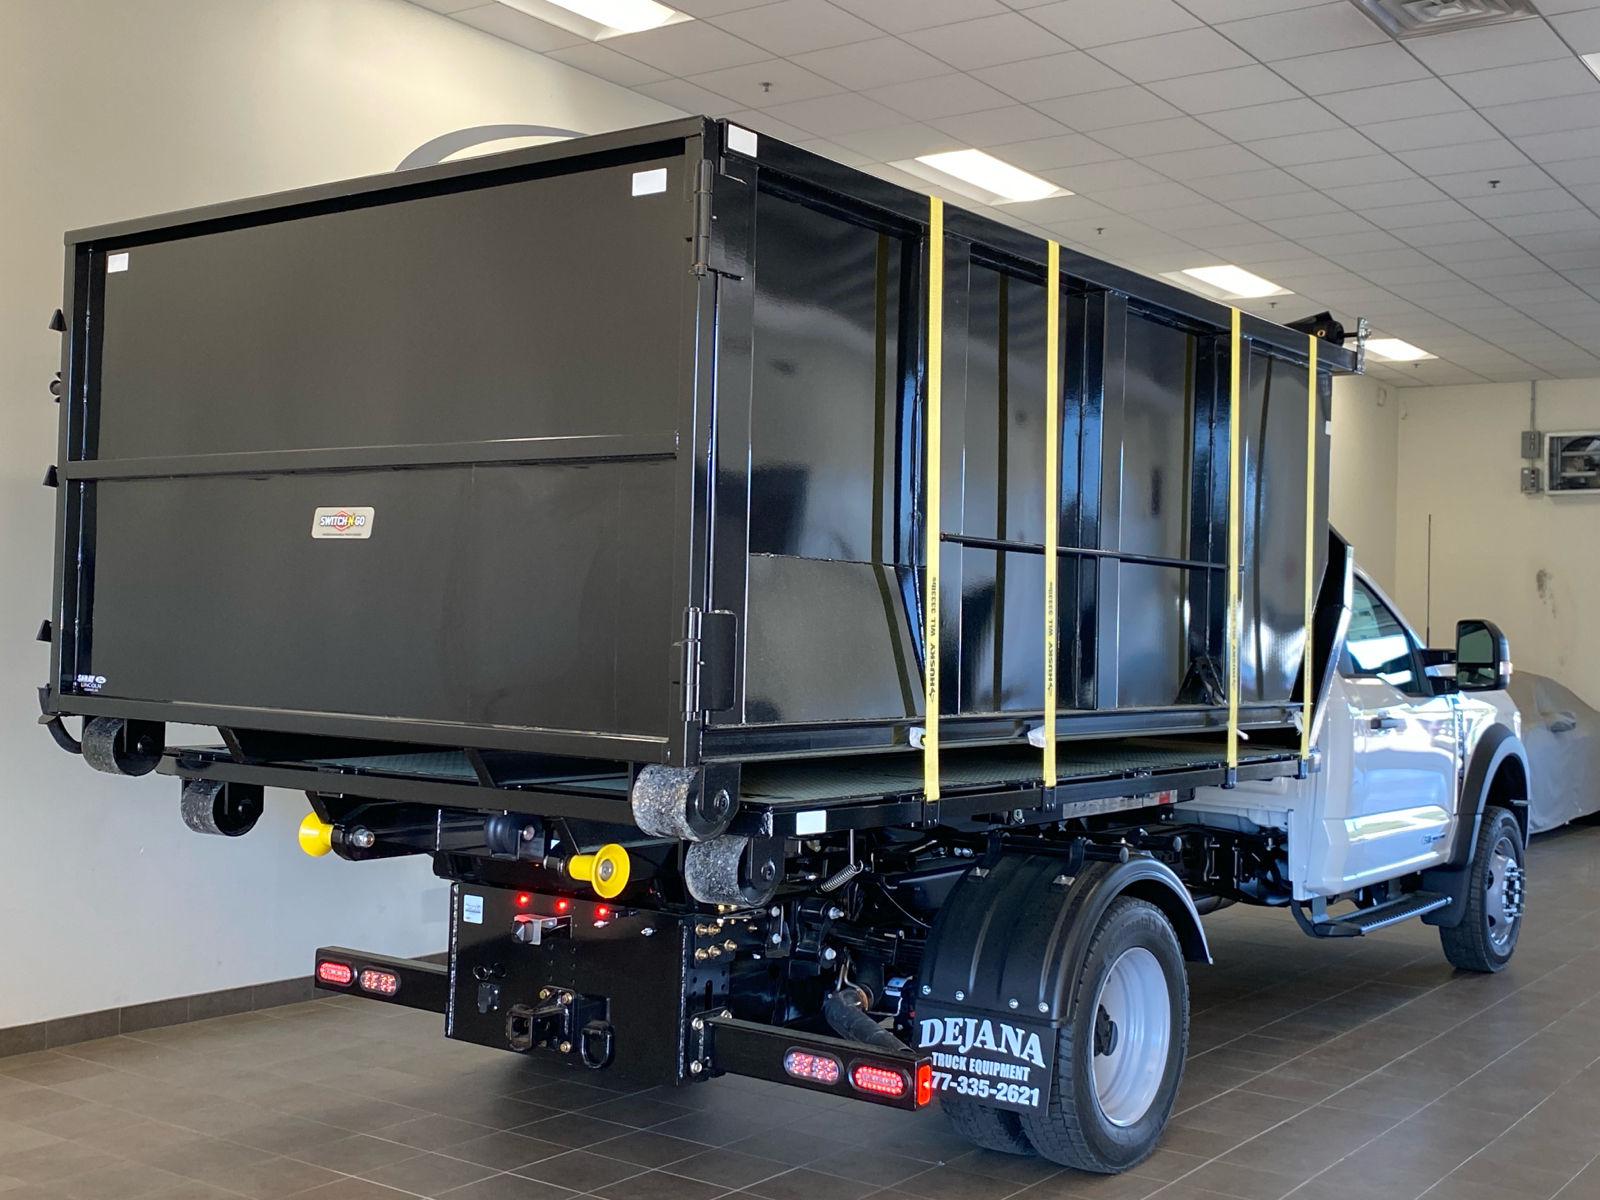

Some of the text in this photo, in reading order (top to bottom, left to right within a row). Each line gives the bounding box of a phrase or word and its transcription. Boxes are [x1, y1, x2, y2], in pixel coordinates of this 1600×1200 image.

[320, 516, 348, 526] SWITCH
[355, 516, 365, 526] GO
[919, 1018, 1046, 1068] DEJANA
[931, 1052, 1031, 1082] TRUCK EQUIPMENT
[931, 1071, 1040, 1107] 77-335-2621
